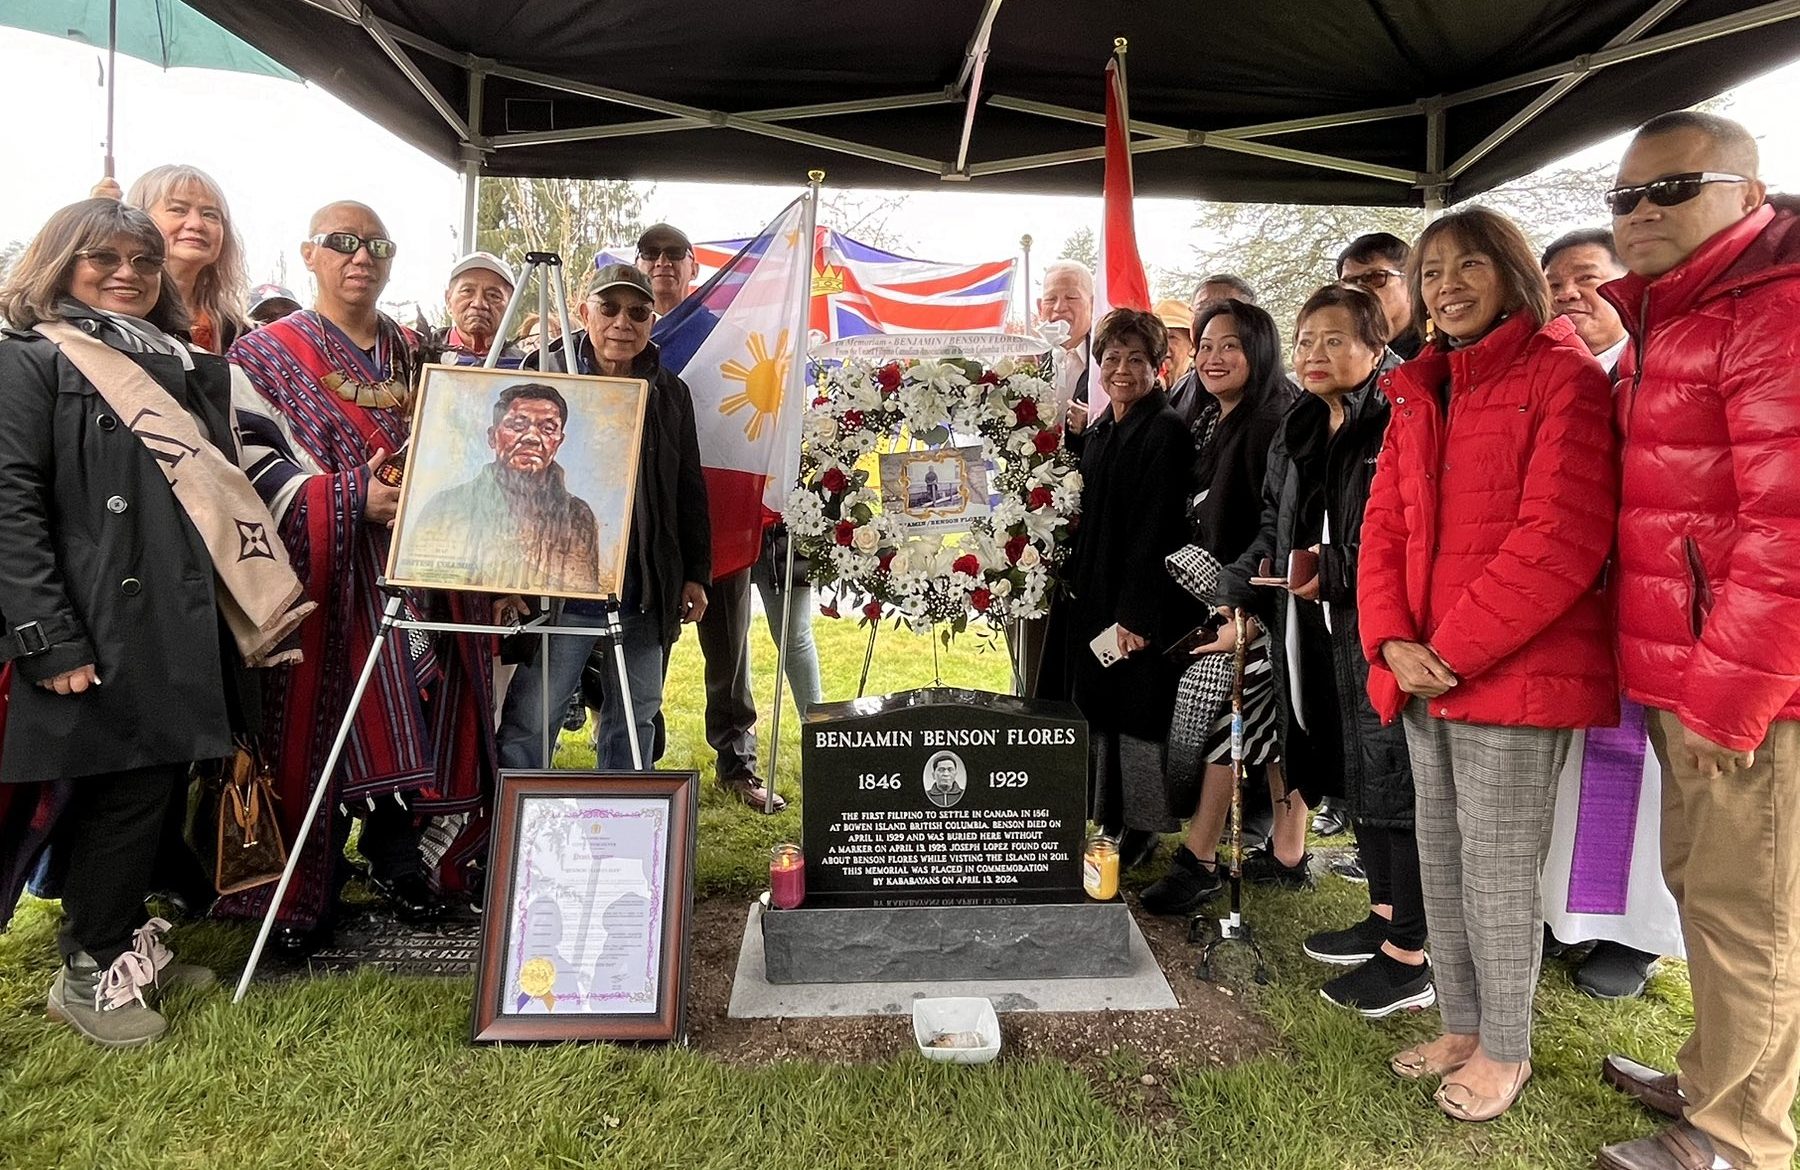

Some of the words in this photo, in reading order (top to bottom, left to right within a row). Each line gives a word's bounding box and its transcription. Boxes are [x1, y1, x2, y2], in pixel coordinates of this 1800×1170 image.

[894, 337, 942, 345] BENJAMIN
[816, 731, 912, 748] BENJAMIN
[1007, 729, 1076, 745] FLORES
[859, 773, 901, 789] 1846
[989, 771, 1028, 787] 1929
[841, 812, 858, 820] THE
[862, 812, 885, 820] FIRST
[888, 811, 923, 819] FILIPINO
[925, 811, 936, 819] TO
[940, 810, 969, 818] SETTLE
[972, 810, 981, 818] IN
[984, 810, 1018, 818] CANADA
[844, 823, 872, 831] BOWEN
[910, 822, 942, 830] BRITISH
[993, 820, 1024, 828] BENSON
[1027, 820, 1047, 828] DIED
[1049, 820, 1061, 828] ON
[848, 834, 873, 842] APRIL
[907, 833, 925, 841] AND
[947, 832, 977, 840] BURIED
[980, 832, 1001, 840] HERE
[1004, 831, 1043, 839] WITHOUT
[838, 845, 873, 853] MARKER
[889, 844, 913, 852] APRIL
[949, 843, 980, 851] JOSEPH
[984, 843, 1008, 851] LOPEZ
[1012, 842, 1039, 850] FOUND
[1041, 842, 1059, 850] OUT
[822, 857, 850, 865] ABOUT
[853, 856, 885, 864] BENSON
[888, 855, 918, 863] FLORES
[921, 855, 947, 863] WHILE
[950, 854, 983, 862] VISTING
[1006, 853, 1036, 861] ISLAND
[1039, 853, 1048, 861] IN
[842, 867, 862, 875] THIS
[865, 866, 909, 874] MEMORIAL
[911, 866, 928, 874] WAS
[931, 865, 962, 873] PLACED
[965, 865, 974, 873] IN
[977, 864, 1048, 872] COMMEMORATION
[873, 878, 884, 886] BY
[886, 877, 940, 885] KABABAYANS
[942, 876, 954, 884] ON
[956, 876, 980, 884] APRIL
